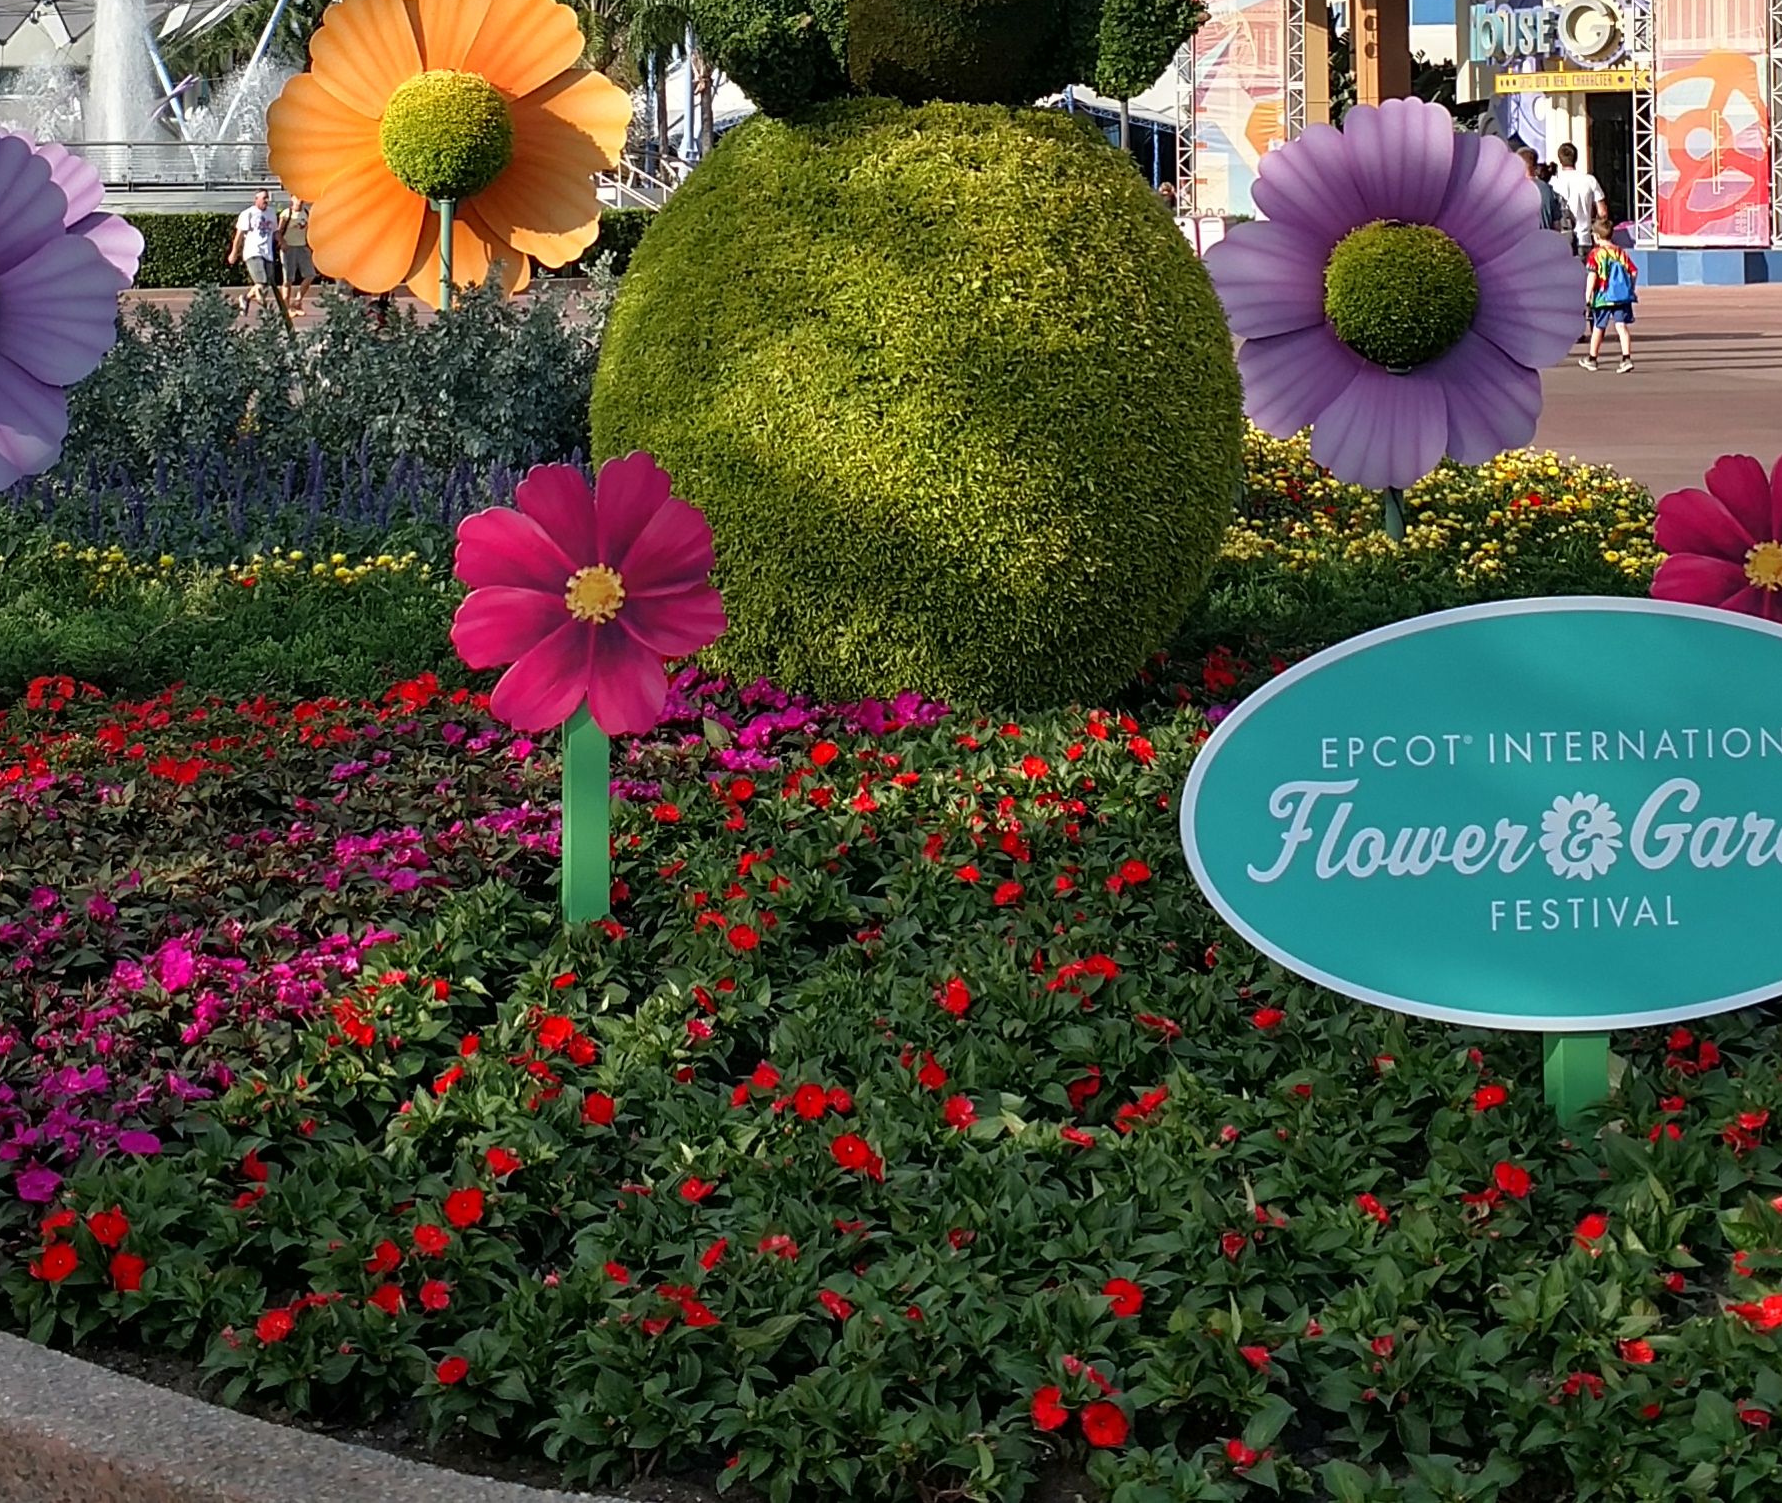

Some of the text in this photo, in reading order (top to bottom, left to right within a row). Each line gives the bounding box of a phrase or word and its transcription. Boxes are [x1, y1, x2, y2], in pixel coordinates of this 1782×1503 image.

[1572, 73, 1613, 87] CHARACTER
[1246, 778, 1537, 883] Flower
[1490, 895, 1680, 932] FESTIVAL
